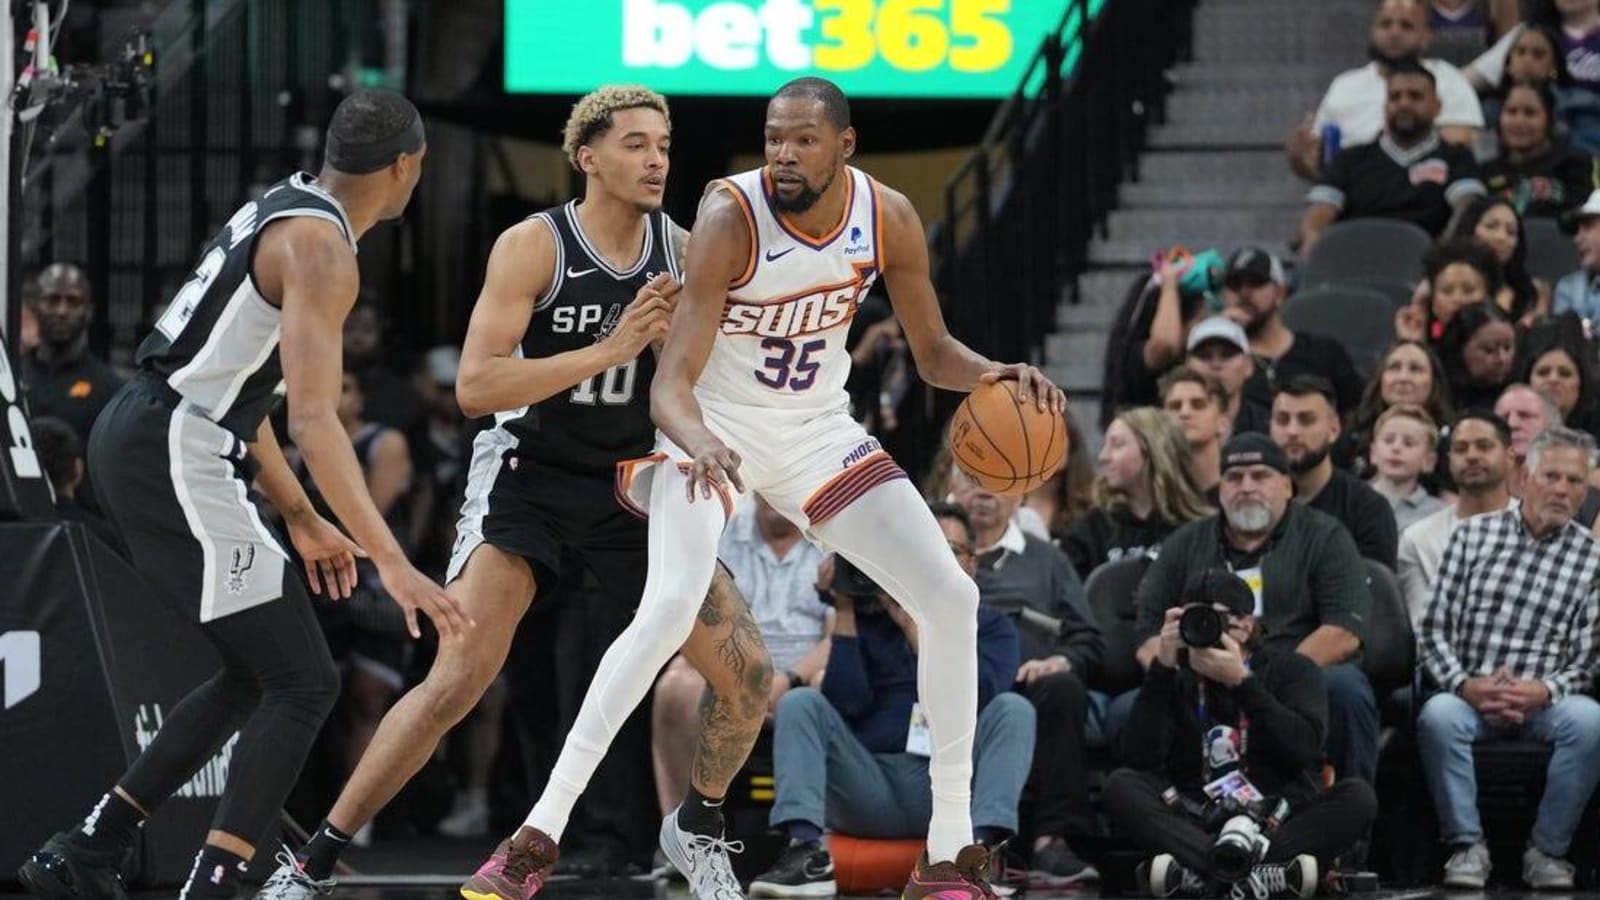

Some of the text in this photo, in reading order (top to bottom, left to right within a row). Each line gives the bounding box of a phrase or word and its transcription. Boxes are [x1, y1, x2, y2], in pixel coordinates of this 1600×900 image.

[622, 0, 1013, 71] bet365
[570, 358, 638, 405] 10
[754, 337, 826, 391] 35
